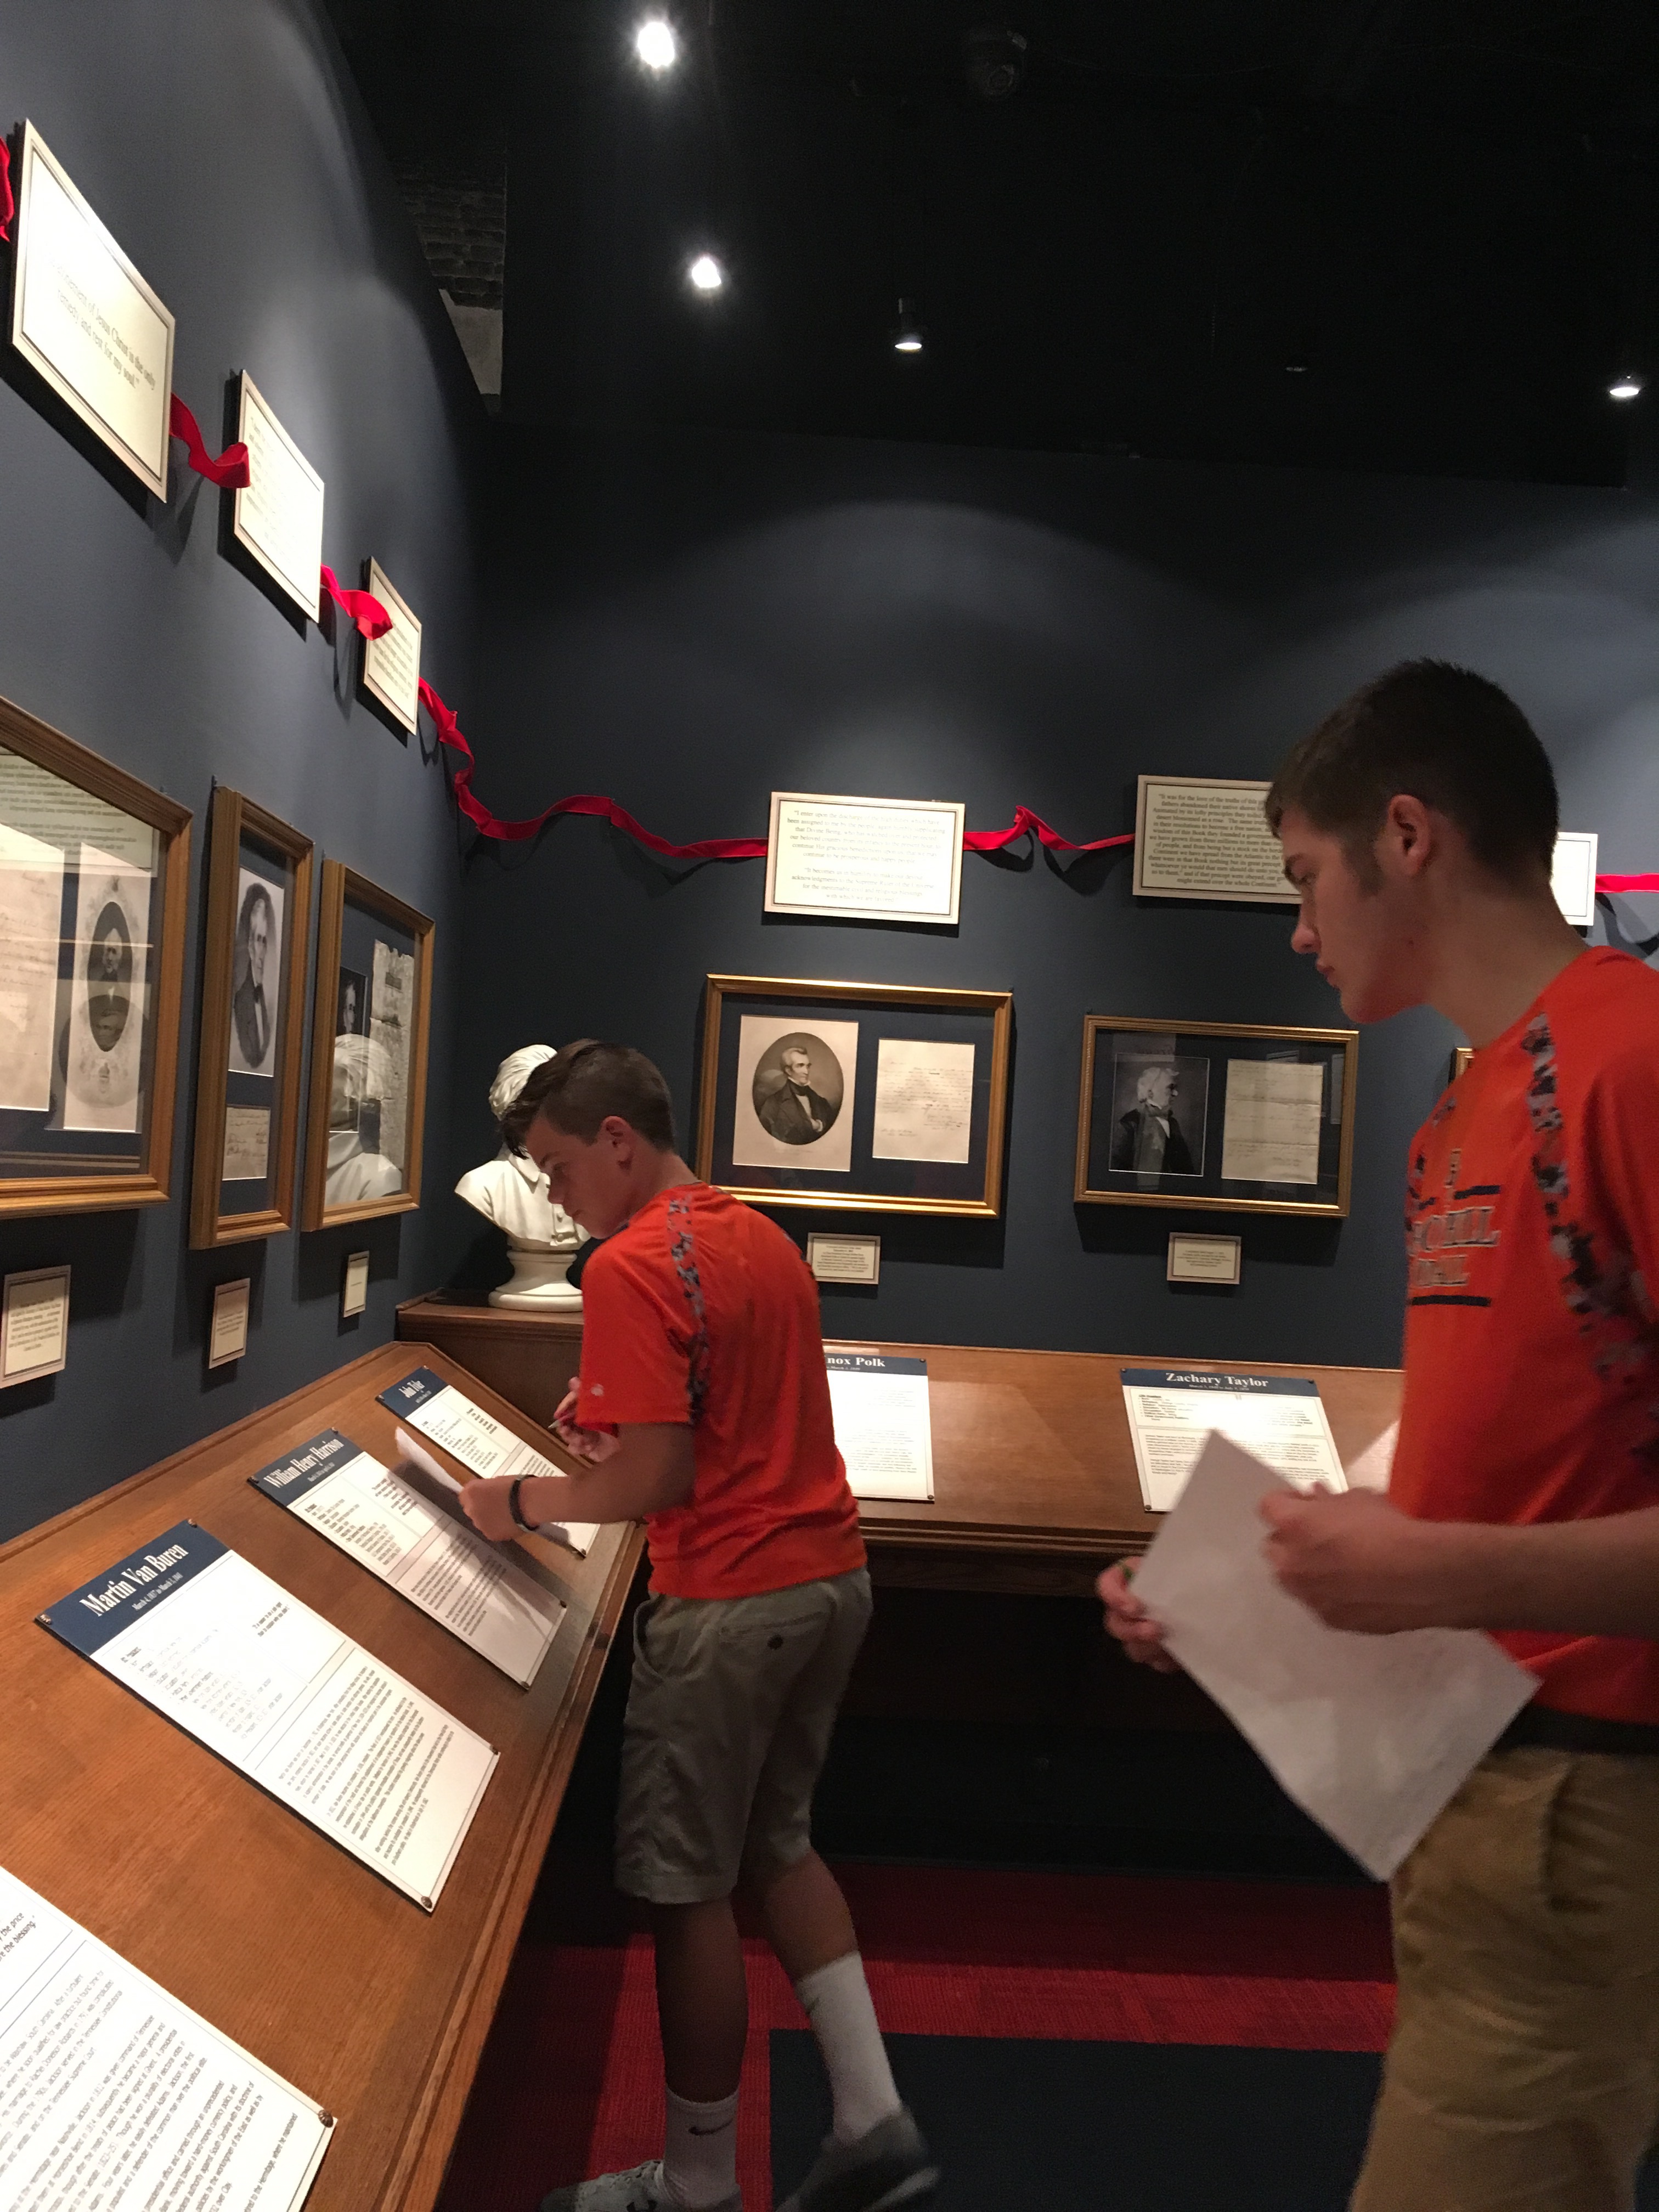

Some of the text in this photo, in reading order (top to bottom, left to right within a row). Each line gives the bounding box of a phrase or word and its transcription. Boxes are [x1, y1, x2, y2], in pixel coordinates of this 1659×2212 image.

[825, 1356, 885, 1367] nox Polk
[407, 1380, 425, 1393] Tyler
[1165, 1372, 1269, 1388] Zachary Taylor
[398, 1386, 417, 1398] John
[263, 1466, 302, 1488] William
[290, 1453, 323, 1472] Henry
[309, 1438, 345, 1460] Harrison
[79, 1544, 189, 1617] Martin Van Buren
[1, 1912, 24, 1937] the price
[3, 1941, 15, 1953] the
